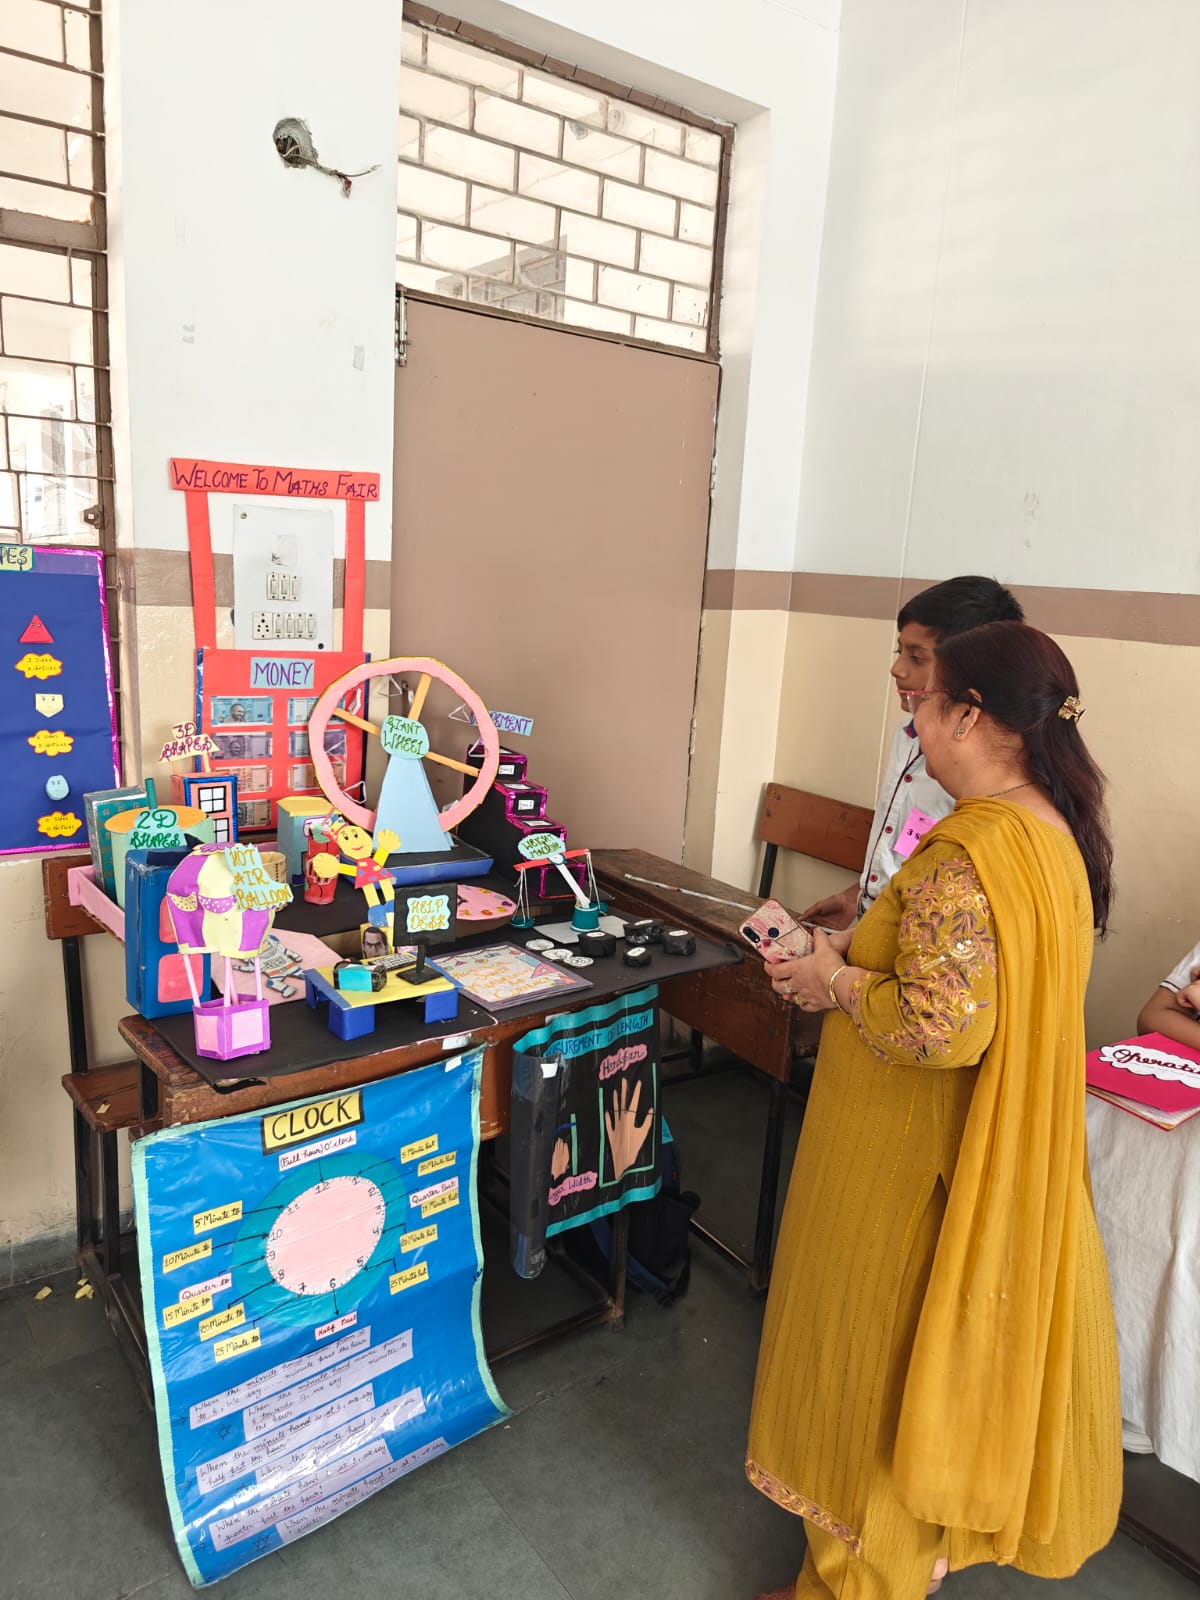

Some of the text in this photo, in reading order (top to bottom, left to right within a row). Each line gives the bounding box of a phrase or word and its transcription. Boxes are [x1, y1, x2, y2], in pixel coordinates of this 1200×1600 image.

[173, 461, 378, 498] WELCOME TO MATHS FAIR
[253, 662, 313, 687] MONEY
[173, 722, 197, 739] 3D
[386, 716, 423, 736] GIANT
[158, 737, 213, 762] SHAPES
[384, 731, 427, 756] WHEEL
[137, 809, 178, 829] 2D
[130, 831, 181, 849] SHAPES
[234, 867, 270, 886] AIR
[410, 898, 444, 914] HELP
[410, 913, 447, 930] DESK
[272, 1096, 353, 1141] CLOCK
[313, 1181, 331, 1195] 12
[375, 1204, 382, 1215] 3
[194, 1217, 203, 1228] 5
[203, 1210, 230, 1226] Minute
[270, 1228, 283, 1242] 10
[372, 1226, 380, 1236] 4
[174, 1247, 202, 1264] Minute
[269, 1250, 276, 1261] 9
[356, 1255, 365, 1268] 5
[277, 1269, 285, 1280] 8
[329, 1277, 336, 1289] 6
[299, 1282, 307, 1292] 7
[165, 1312, 174, 1322] 15
[174, 1302, 200, 1319] Minute
[208, 1312, 234, 1330] Minute
[226, 1338, 250, 1353] Minute
[199, 1460, 228, 1478] When
[287, 1416, 311, 1433] hand
[216, 1517, 241, 1531] When
